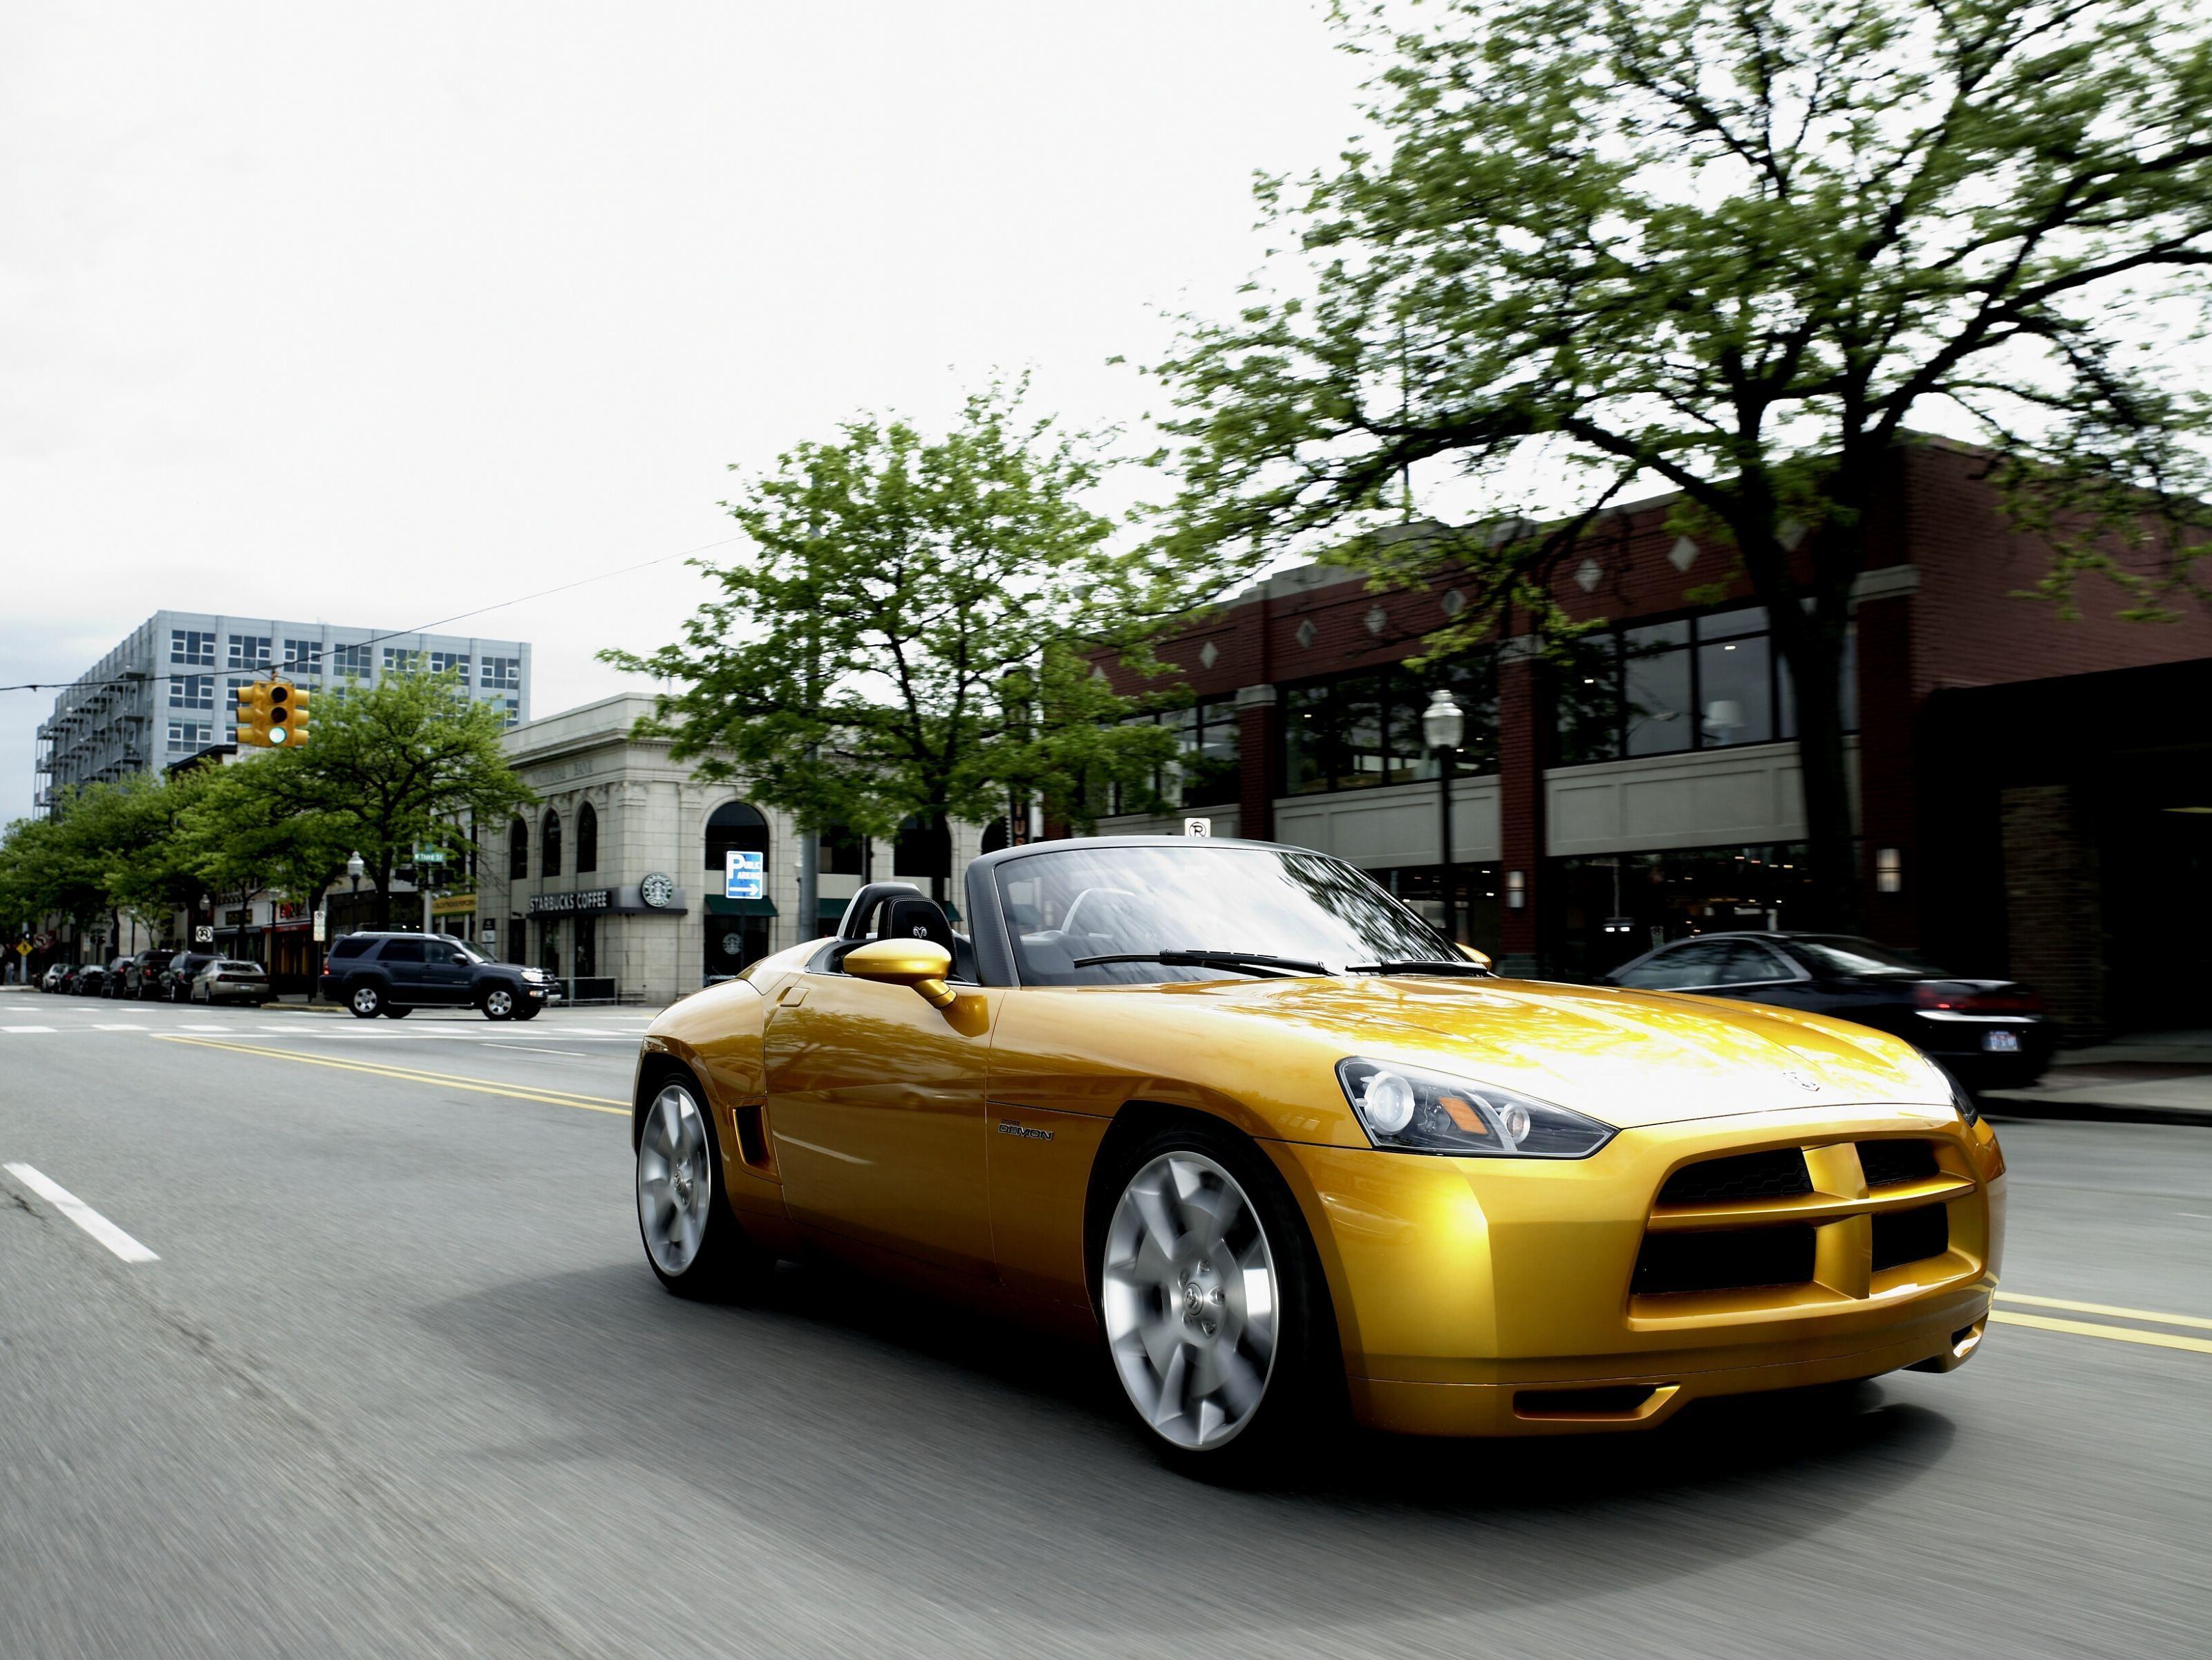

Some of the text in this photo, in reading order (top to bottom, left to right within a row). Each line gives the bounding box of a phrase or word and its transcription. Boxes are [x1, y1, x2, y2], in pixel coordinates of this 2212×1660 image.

[530, 890, 607, 913] STARBUCKS COFFEE
[998, 1123, 1053, 1141] DEMON
